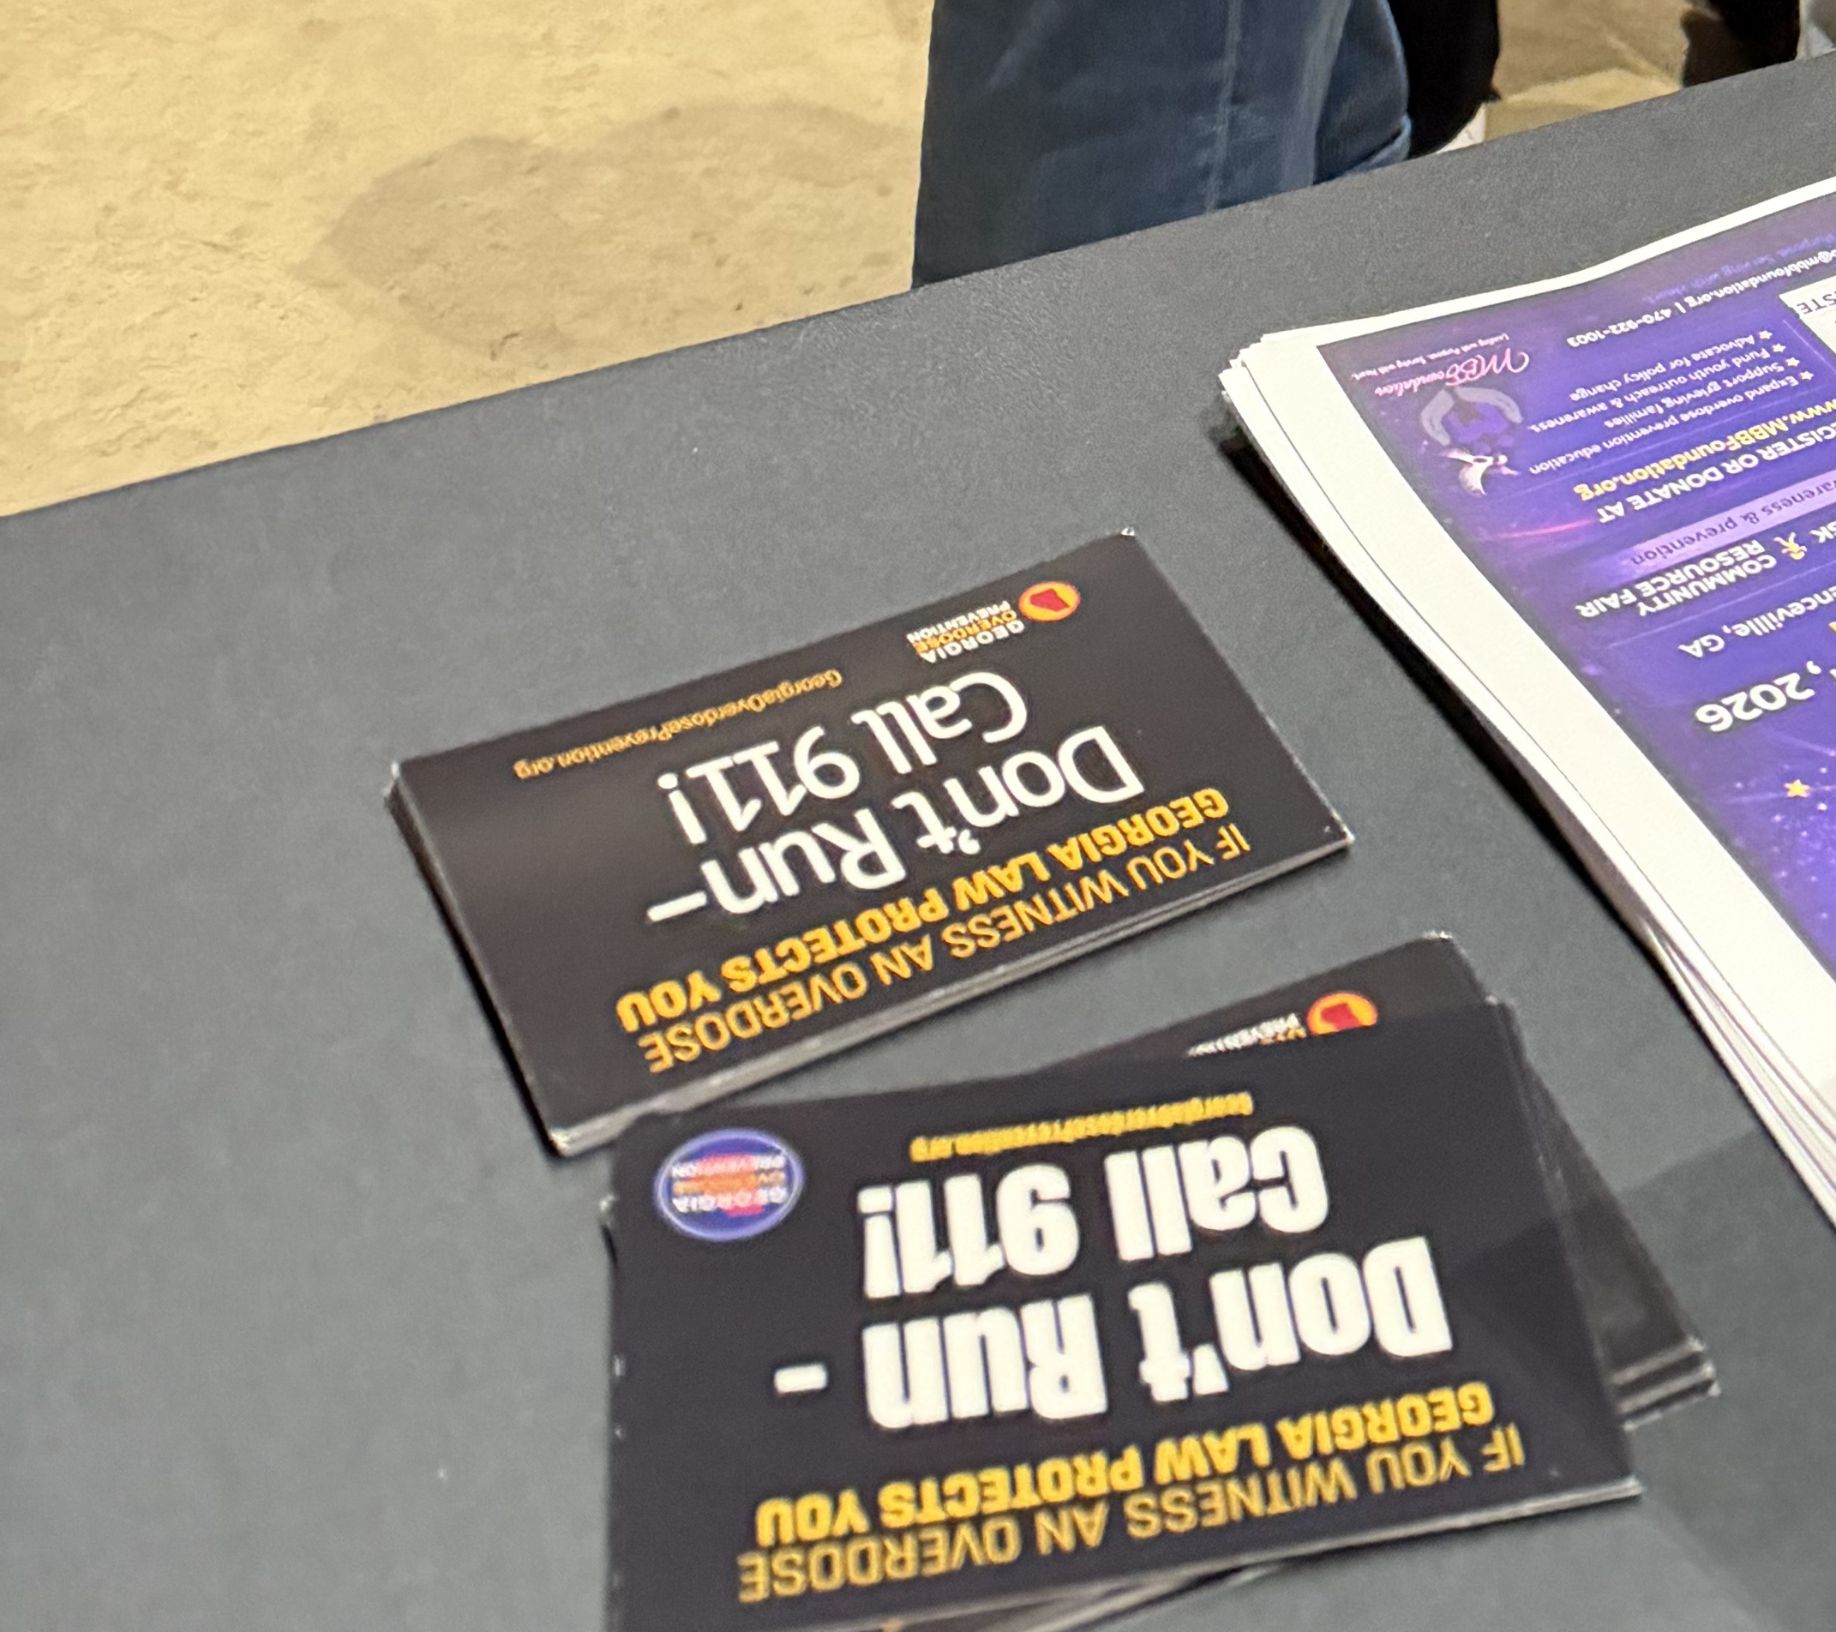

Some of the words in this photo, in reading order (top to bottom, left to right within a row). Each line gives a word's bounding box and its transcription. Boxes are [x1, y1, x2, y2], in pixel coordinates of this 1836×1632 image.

[1622, 361, 1666, 383] policy
[1668, 356, 1691, 370] for
[1687, 357, 1731, 381] youth
[1721, 361, 1785, 388] Support
[1730, 347, 1770, 368] Fund
[1568, 379, 1622, 401] change
[1603, 403, 1664, 428] families
[1660, 380, 1722, 408] grieving
[1528, 444, 1601, 474] education
[1720, 453, 1759, 474] OR
[1596, 500, 1624, 523] AT
[1625, 465, 1724, 510] DONATE
[1620, 515, 1738, 566] prevention
[1739, 510, 1760, 524] &
[1634, 539, 1765, 597] RESOURCE
[1636, 553, 1777, 616] COMMUNITY
[906, 600, 1014, 645] PREVENTION
[1574, 588, 1637, 617] FAIR
[910, 608, 1018, 654] OVERDOSE
[918, 619, 1024, 663] GEORGIA
[1677, 633, 1725, 657] GA
[513, 668, 843, 779] GeorgiaOverdosePrevention.org
[849, 671, 1027, 774] Call
[1694, 672, 1815, 732] 2026
[656, 725, 860, 844] 911!
[1046, 787, 1229, 870] GEORGIA
[1216, 822, 1250, 860] IF
[951, 850, 1051, 911] LAW
[1126, 838, 1214, 890] YOU
[720, 887, 949, 992] PROTECTS
[941, 868, 1129, 958] WITNESS
[869, 933, 933, 985] AN
[615, 970, 722, 1032] YOU
[637, 962, 867, 1072] OVERDOSE
[669, 1183, 787, 1215] GEORGIA
[1104, 1126, 1328, 1261] Call
[857, 1163, 1079, 1298] 911!
[1127, 1236, 1452, 1402] Don't
[862, 1294, 1107, 1429] Run
[1273, 1377, 1499, 1465] GEORGIA
[1475, 1422, 1524, 1472] IF
[1154, 1423, 1270, 1484] LAW
[1365, 1436, 1471, 1493] YOU
[877, 1444, 1144, 1528] PROTECTS
[1118, 1457, 1357, 1538] WITNESS
[756, 1489, 869, 1547] YOU
[1034, 1501, 1108, 1555] AN
[738, 1516, 1020, 1602] OVERDOSE
